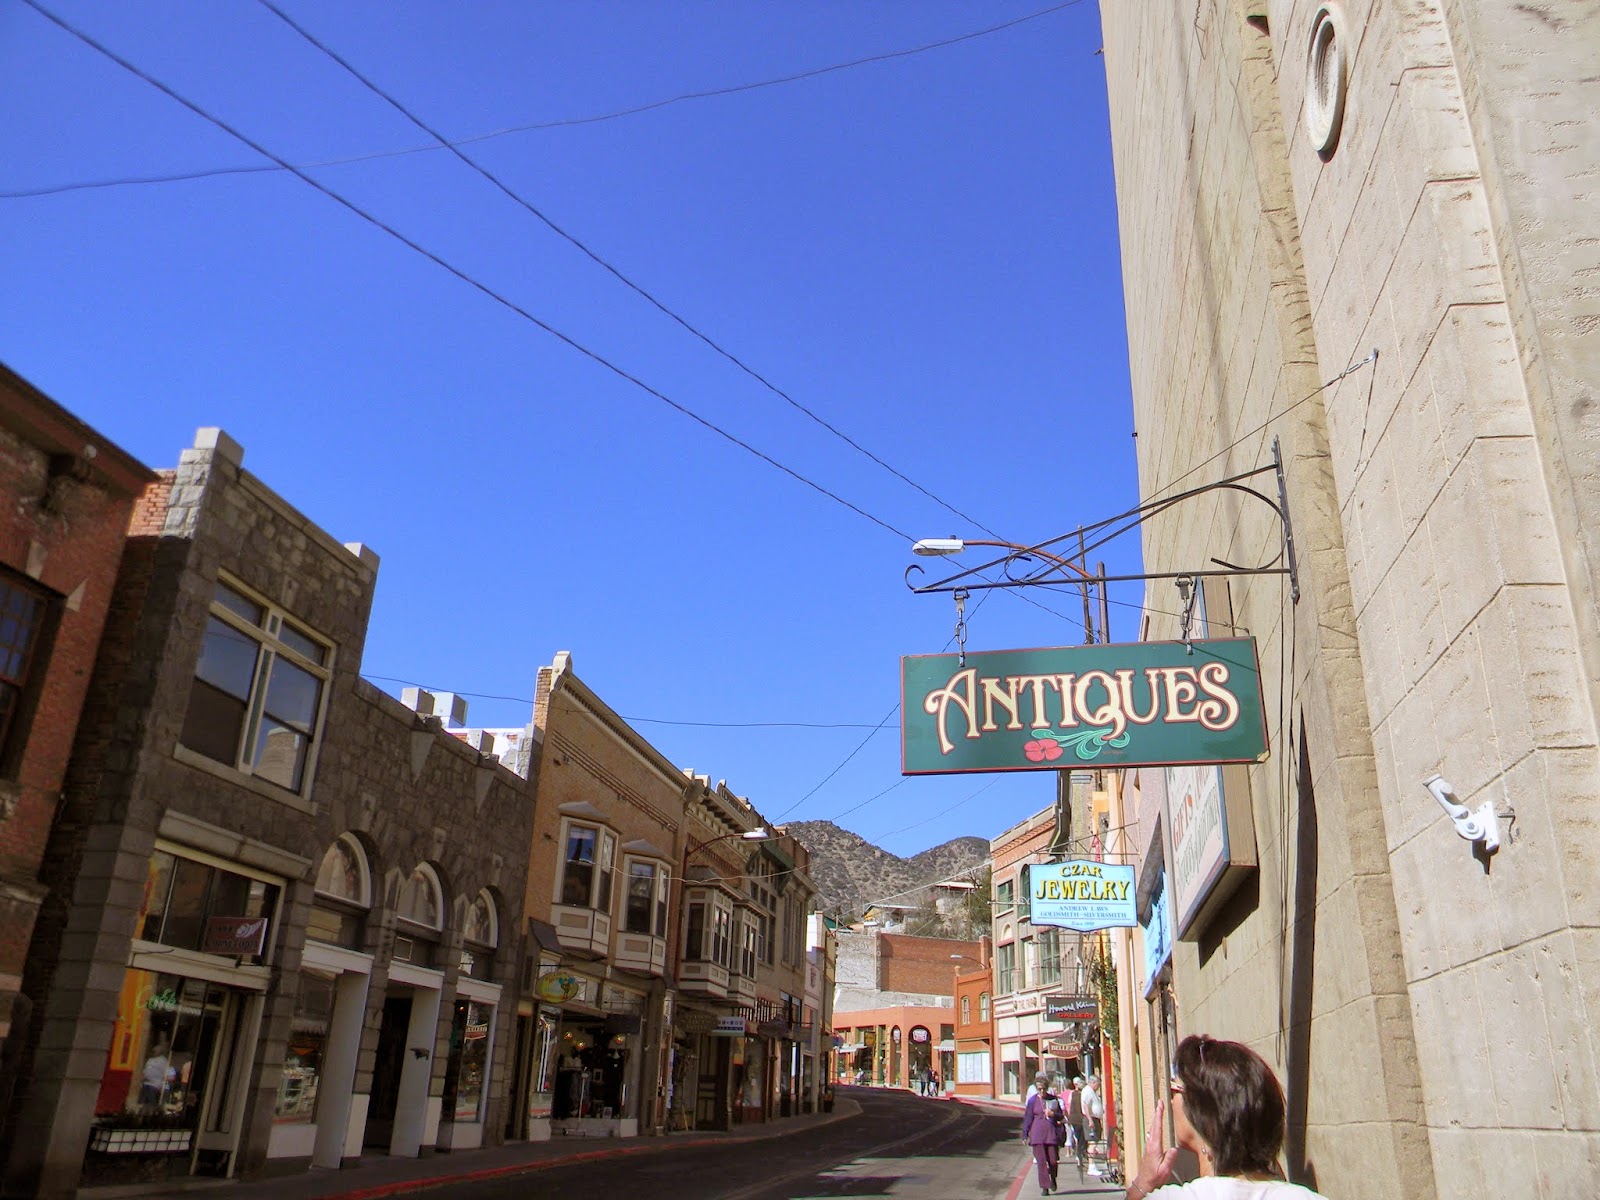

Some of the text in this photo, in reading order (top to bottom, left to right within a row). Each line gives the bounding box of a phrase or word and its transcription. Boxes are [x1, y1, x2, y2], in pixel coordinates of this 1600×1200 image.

[923, 661, 1240, 755] ANTIQUES
[1061, 864, 1103, 878] CZAR
[1035, 879, 1130, 900] JEWELRY
